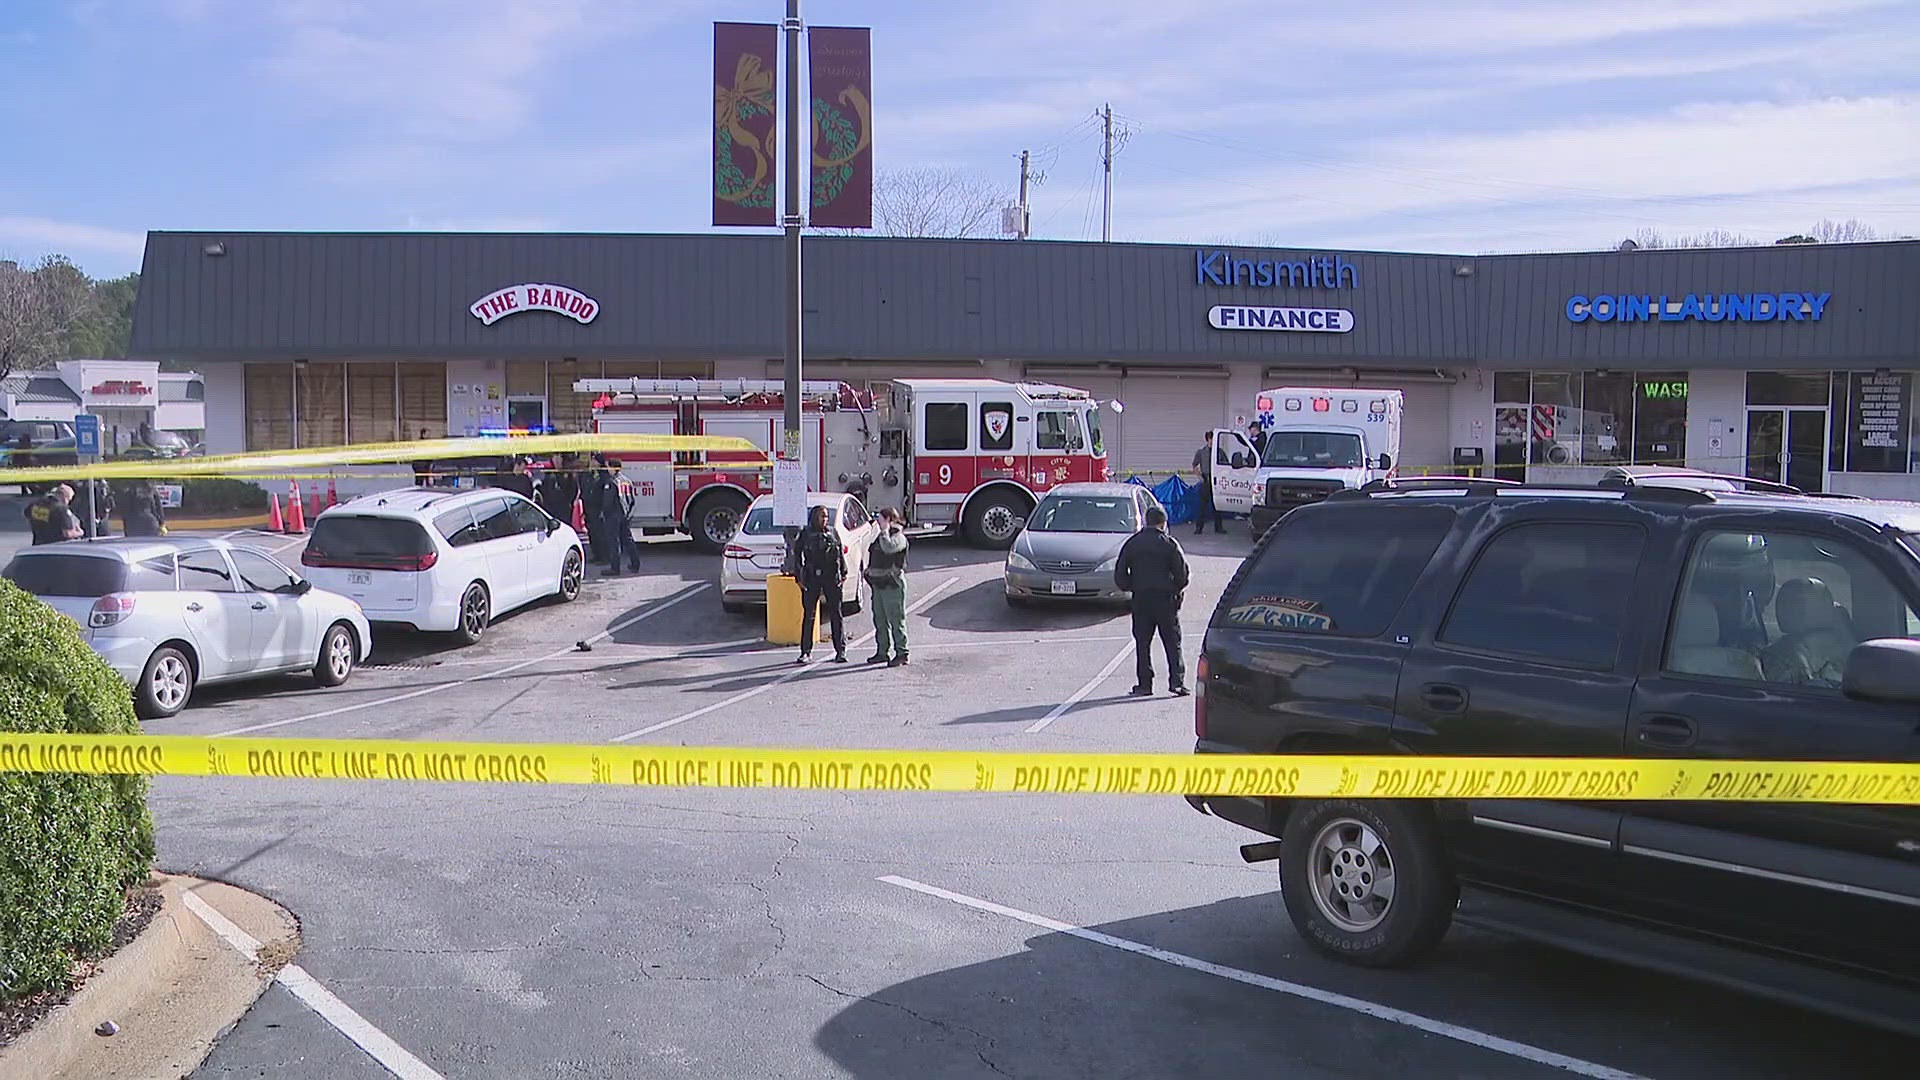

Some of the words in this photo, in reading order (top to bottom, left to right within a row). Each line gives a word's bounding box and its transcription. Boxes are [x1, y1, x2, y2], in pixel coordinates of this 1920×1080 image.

[1195, 250, 1358, 288] Kinsmith
[476, 291, 518, 319] THE
[526, 288, 594, 319] BANDO
[1566, 294, 1650, 322] COIN
[1658, 292, 1831, 322] LAUNDRY
[1220, 308, 1341, 329] FINANCE
[1367, 413, 1385, 422] 539
[939, 464, 951, 485] 9
[1050, 457, 1064, 465] CITY
[642, 487, 655, 496] 911
[1230, 479, 1252, 491] Grady
[40, 744, 83, 771] NOT
[91, 745, 167, 774] CROSS
[248, 750, 322, 778] POLICE
[331, 751, 378, 778] LINE
[386, 752, 418, 780] DO
[423, 753, 467, 781] NOT
[474, 754, 548, 783] CROSS
[633, 759, 709, 786] POLICE
[717, 760, 763, 787] LINE
[772, 761, 800, 788] DO
[810, 762, 853, 789] NOT
[860, 762, 931, 790] CROSS
[1013, 766, 1089, 792] POLICE
[1094, 767, 1142, 793] LINE
[1146, 767, 1176, 793] DO
[1181, 767, 1225, 794] NOT
[1228, 767, 1300, 795] CROSS
[1371, 769, 1446, 796] POLICE
[1444, 770, 1494, 797] LINE
[1494, 770, 1527, 796] DO
[1527, 770, 1572, 797] NOT
[1569, 770, 1638, 796] CROSS
[1702, 772, 1773, 798] POLICE
[1767, 773, 1818, 798] LINE
